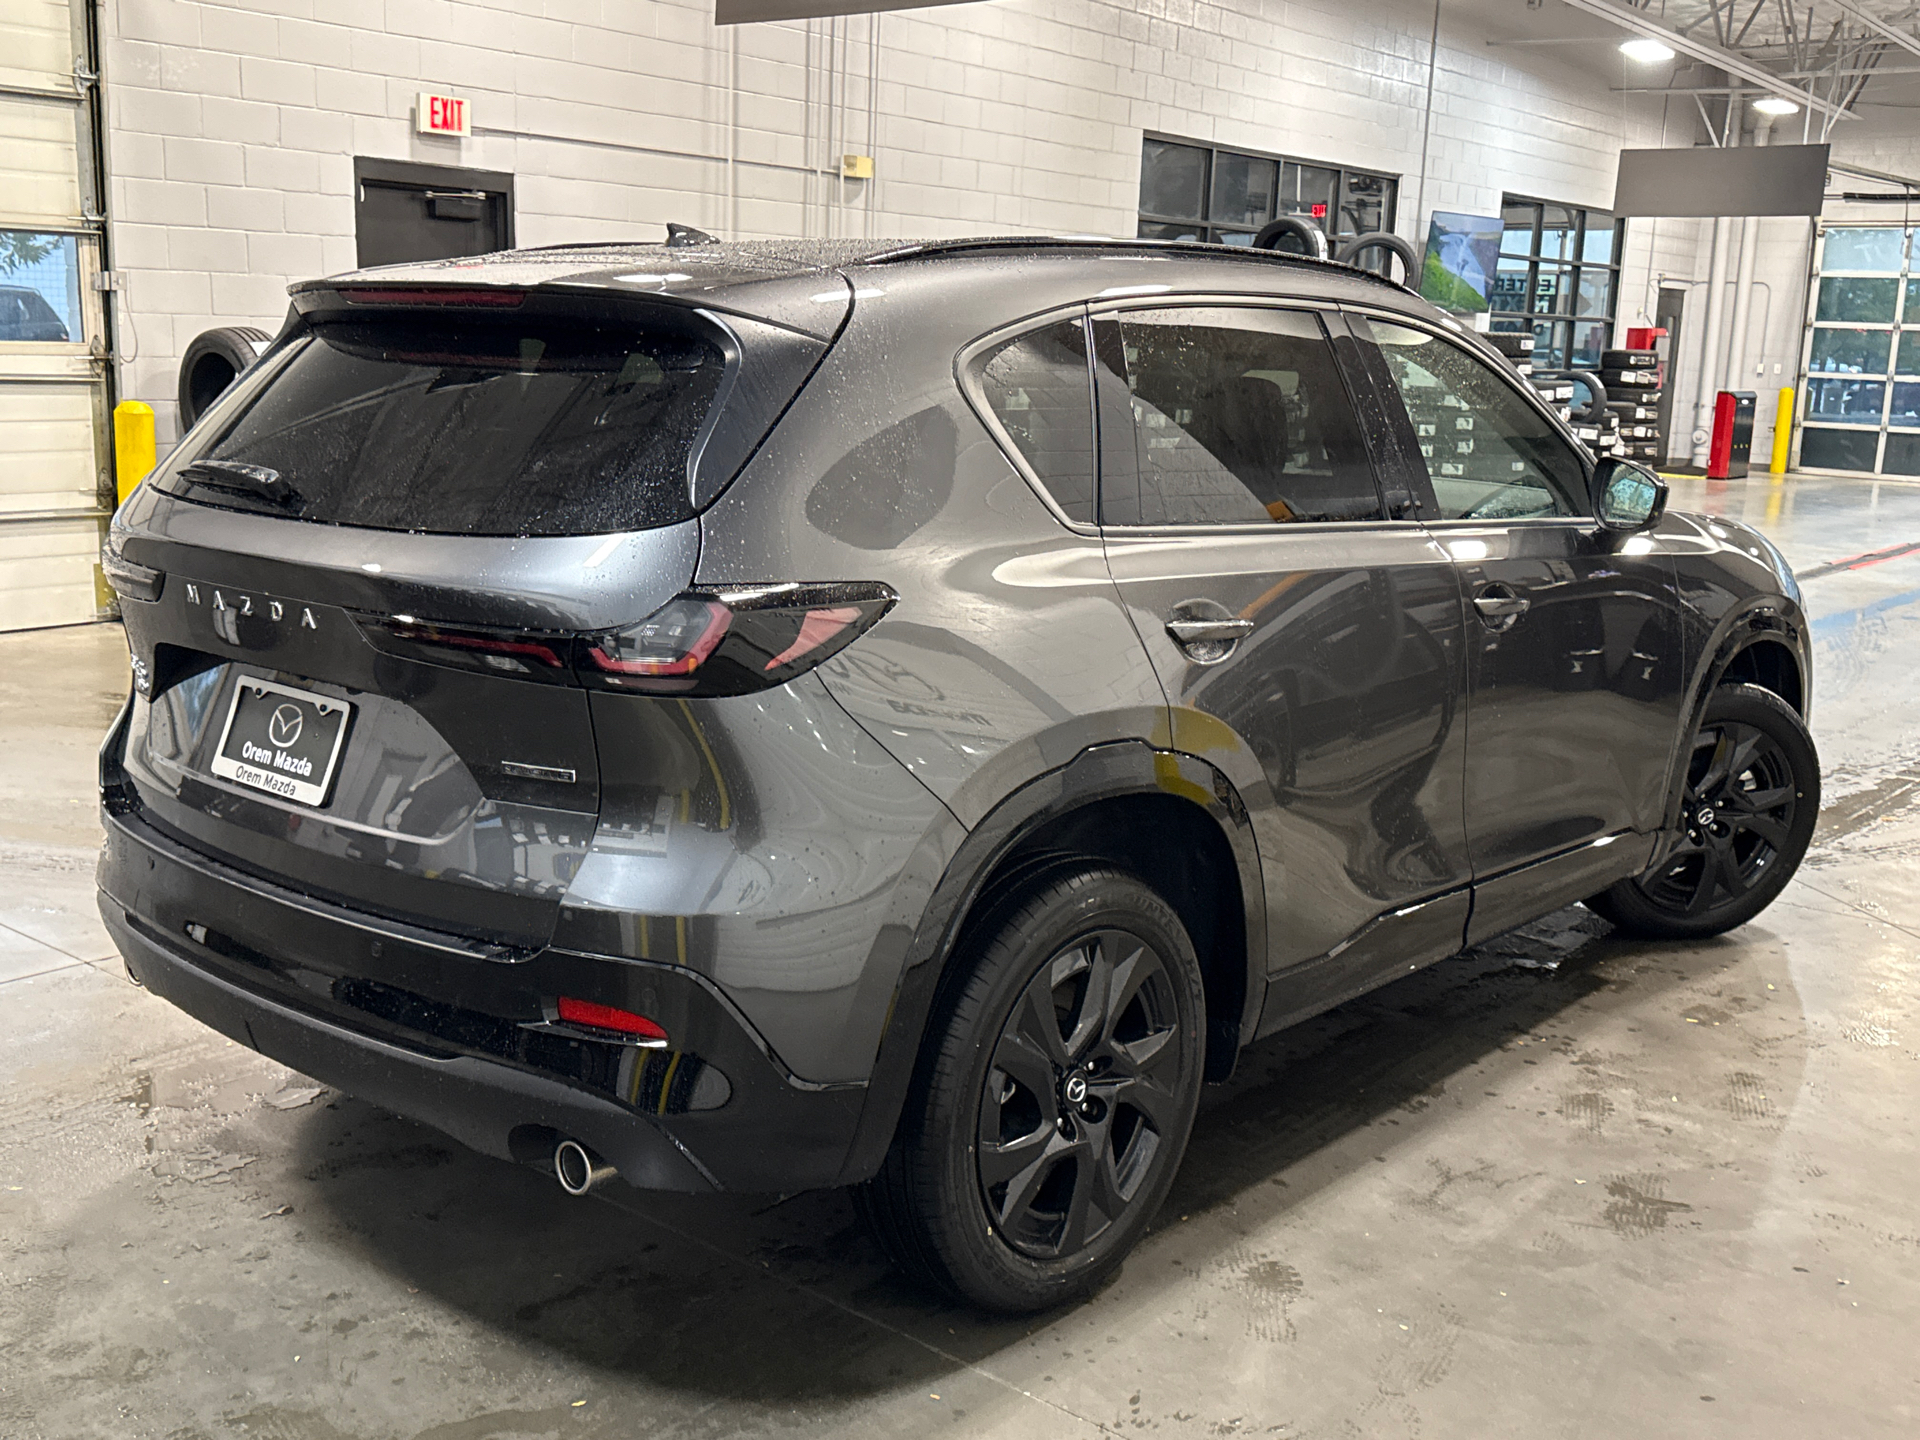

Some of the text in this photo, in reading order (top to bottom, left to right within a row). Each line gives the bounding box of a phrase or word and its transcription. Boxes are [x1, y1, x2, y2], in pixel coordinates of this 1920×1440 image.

[430, 96, 464, 132] EXIT
[186, 583, 317, 630] MAZDA
[242, 740, 313, 777] Orem Mazda
[235, 765, 297, 796] Orem Mazda
